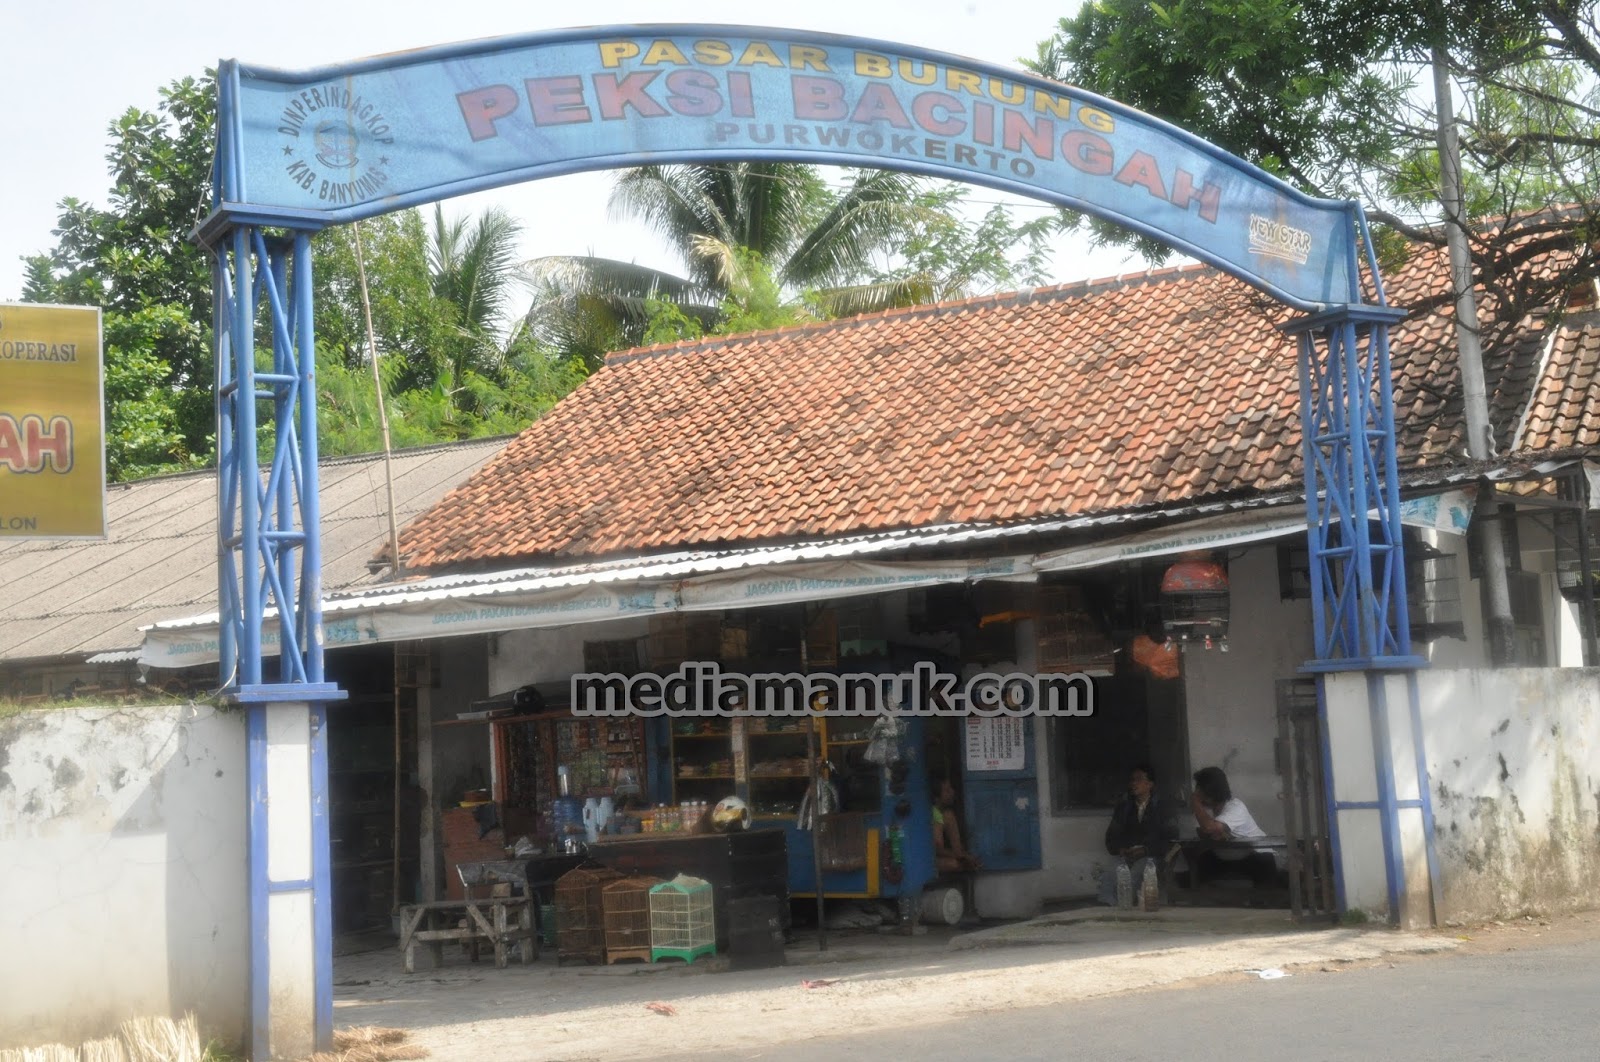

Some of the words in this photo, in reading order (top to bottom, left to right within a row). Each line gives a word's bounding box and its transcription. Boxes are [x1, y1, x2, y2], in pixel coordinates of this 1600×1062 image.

[278, 86, 394, 145] DINPERINDAGKOP
[597, 39, 830, 73] PASAR
[854, 52, 1115, 135] BURUNG
[455, 69, 757, 143] PEKSI
[790, 74, 1222, 225] BACINGAH
[714, 122, 1036, 181] PURWOKERTO
[286, 160, 317, 194] KAB.
[319, 167, 388, 204] BANYUMAS
[1249, 212, 1279, 241] NEW
[1280, 225, 1311, 254] STAR
[0, 341, 77, 362] OPERASI
